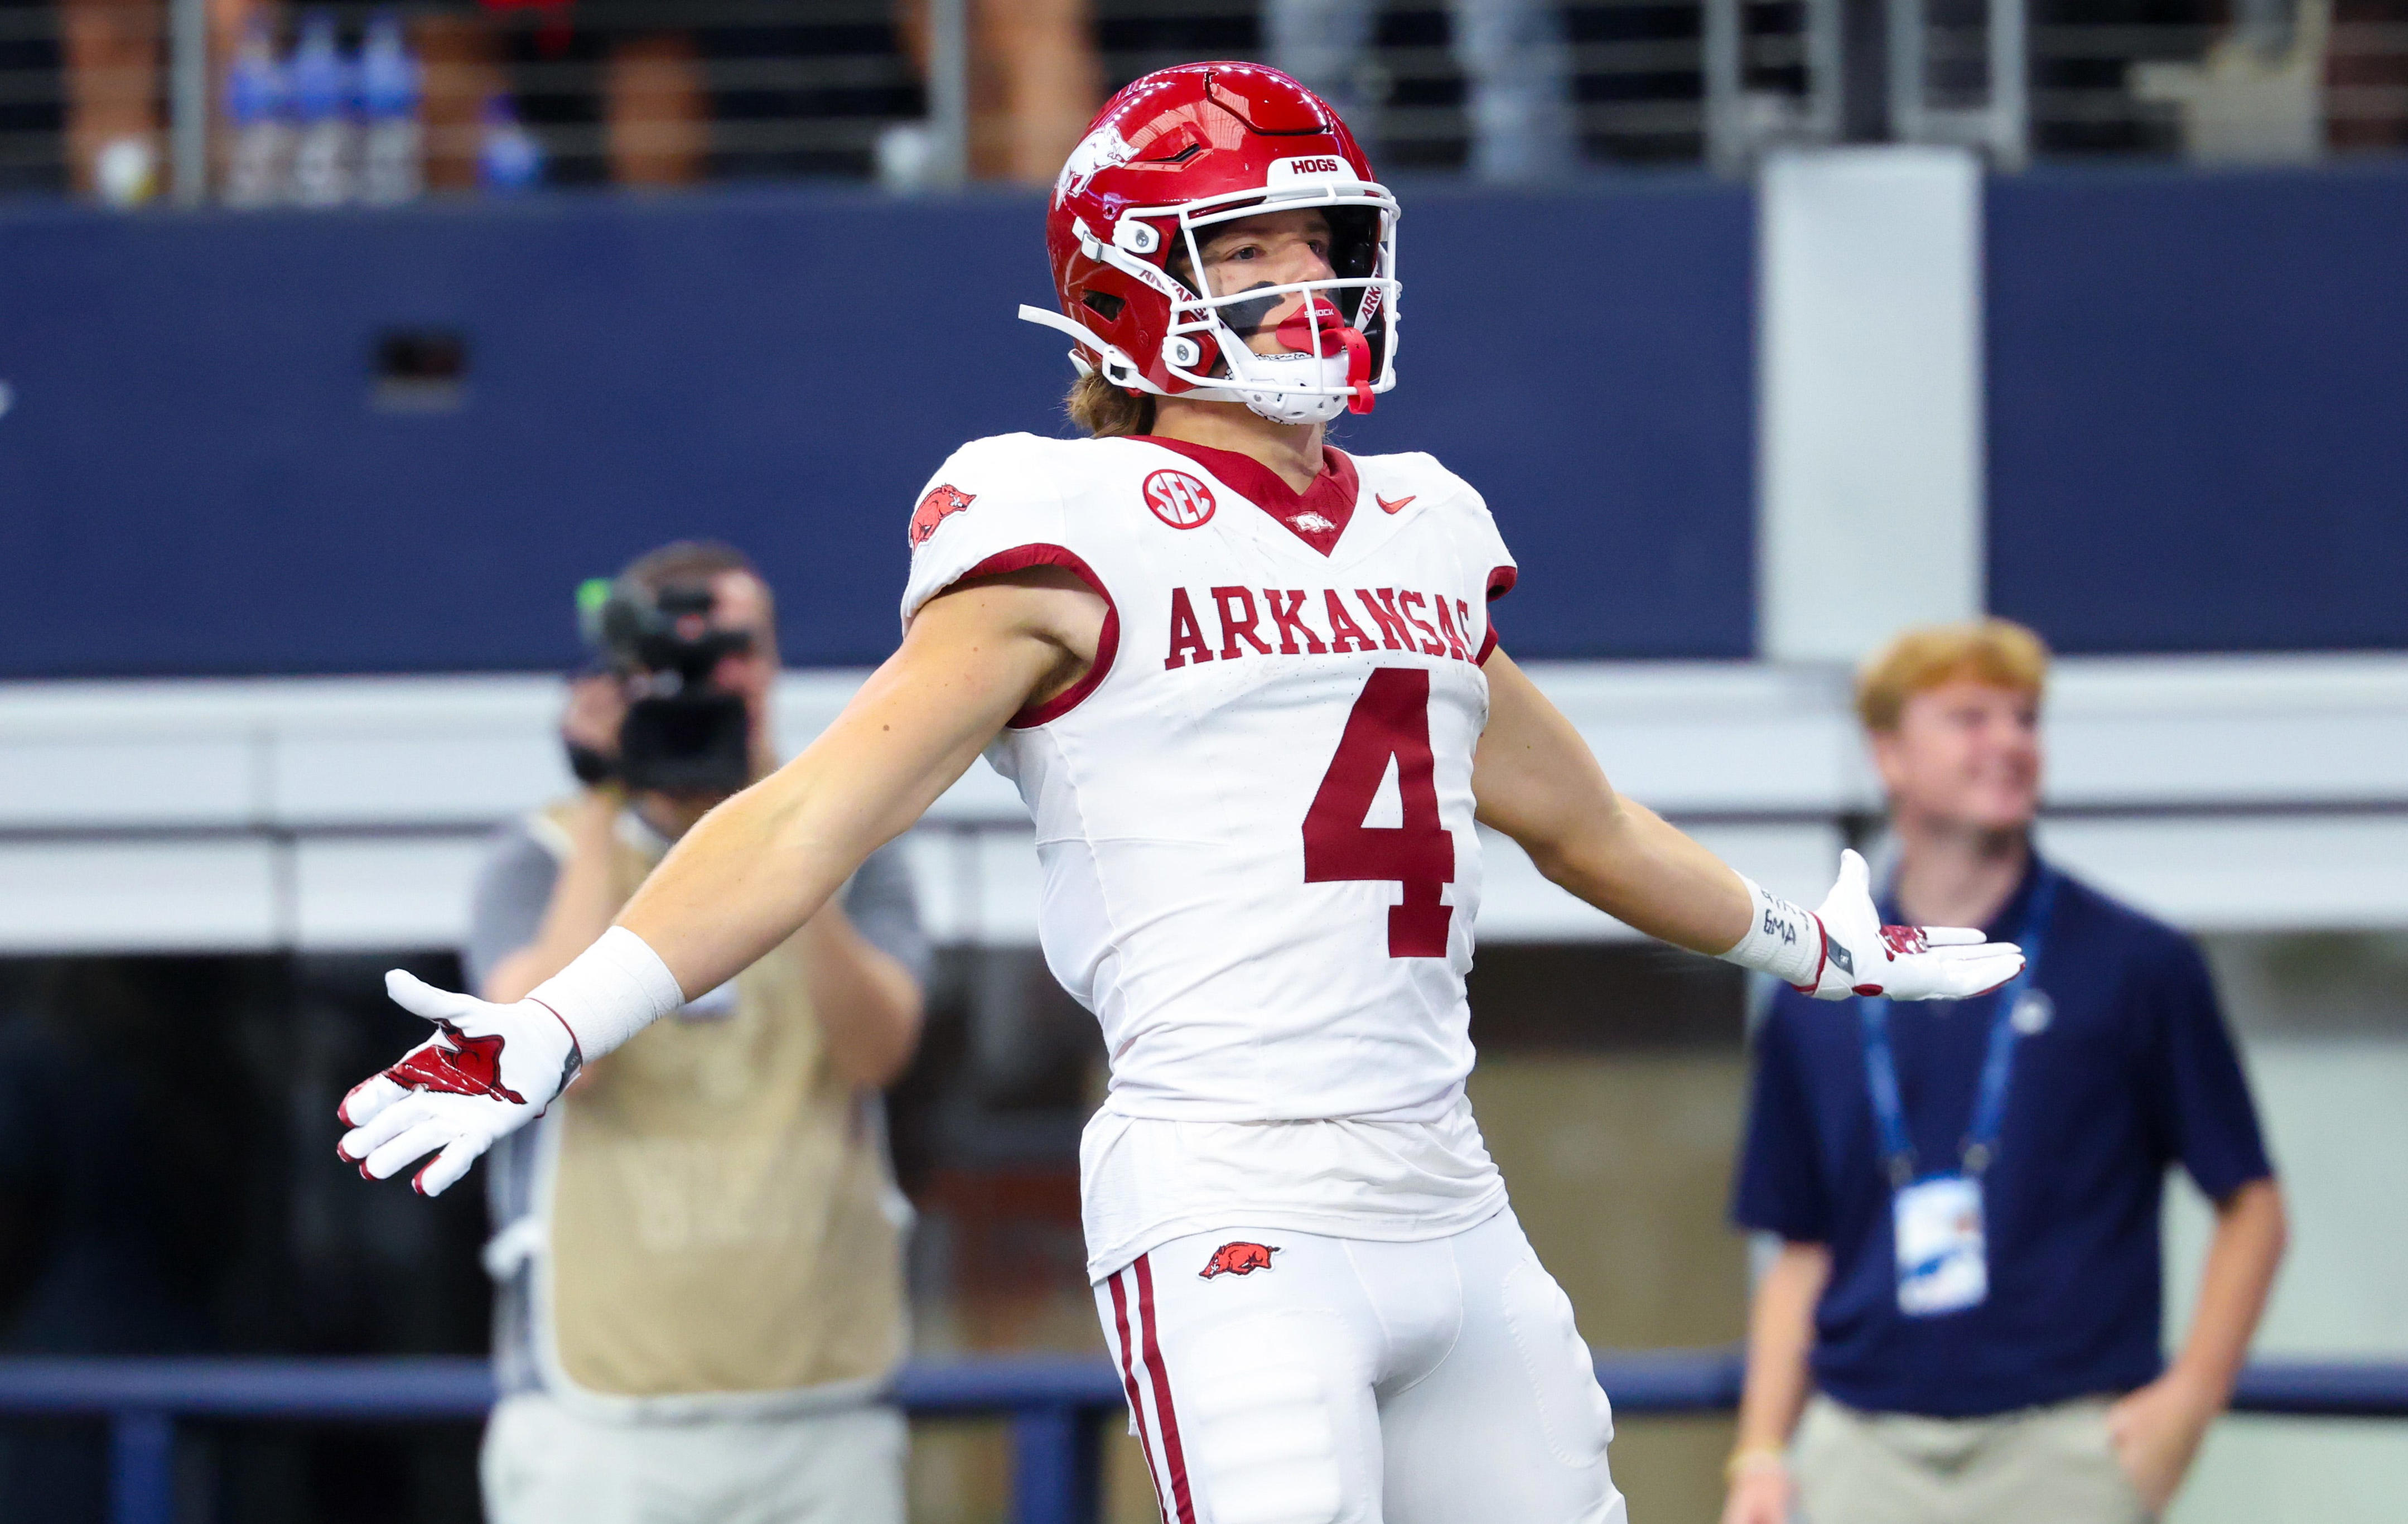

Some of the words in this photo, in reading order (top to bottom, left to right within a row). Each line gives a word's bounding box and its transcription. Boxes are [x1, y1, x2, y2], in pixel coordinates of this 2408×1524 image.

[1291, 158, 1338, 174] HOGS
[1148, 472, 1210, 524] SEC
[1302, 667, 1455, 958] 4
